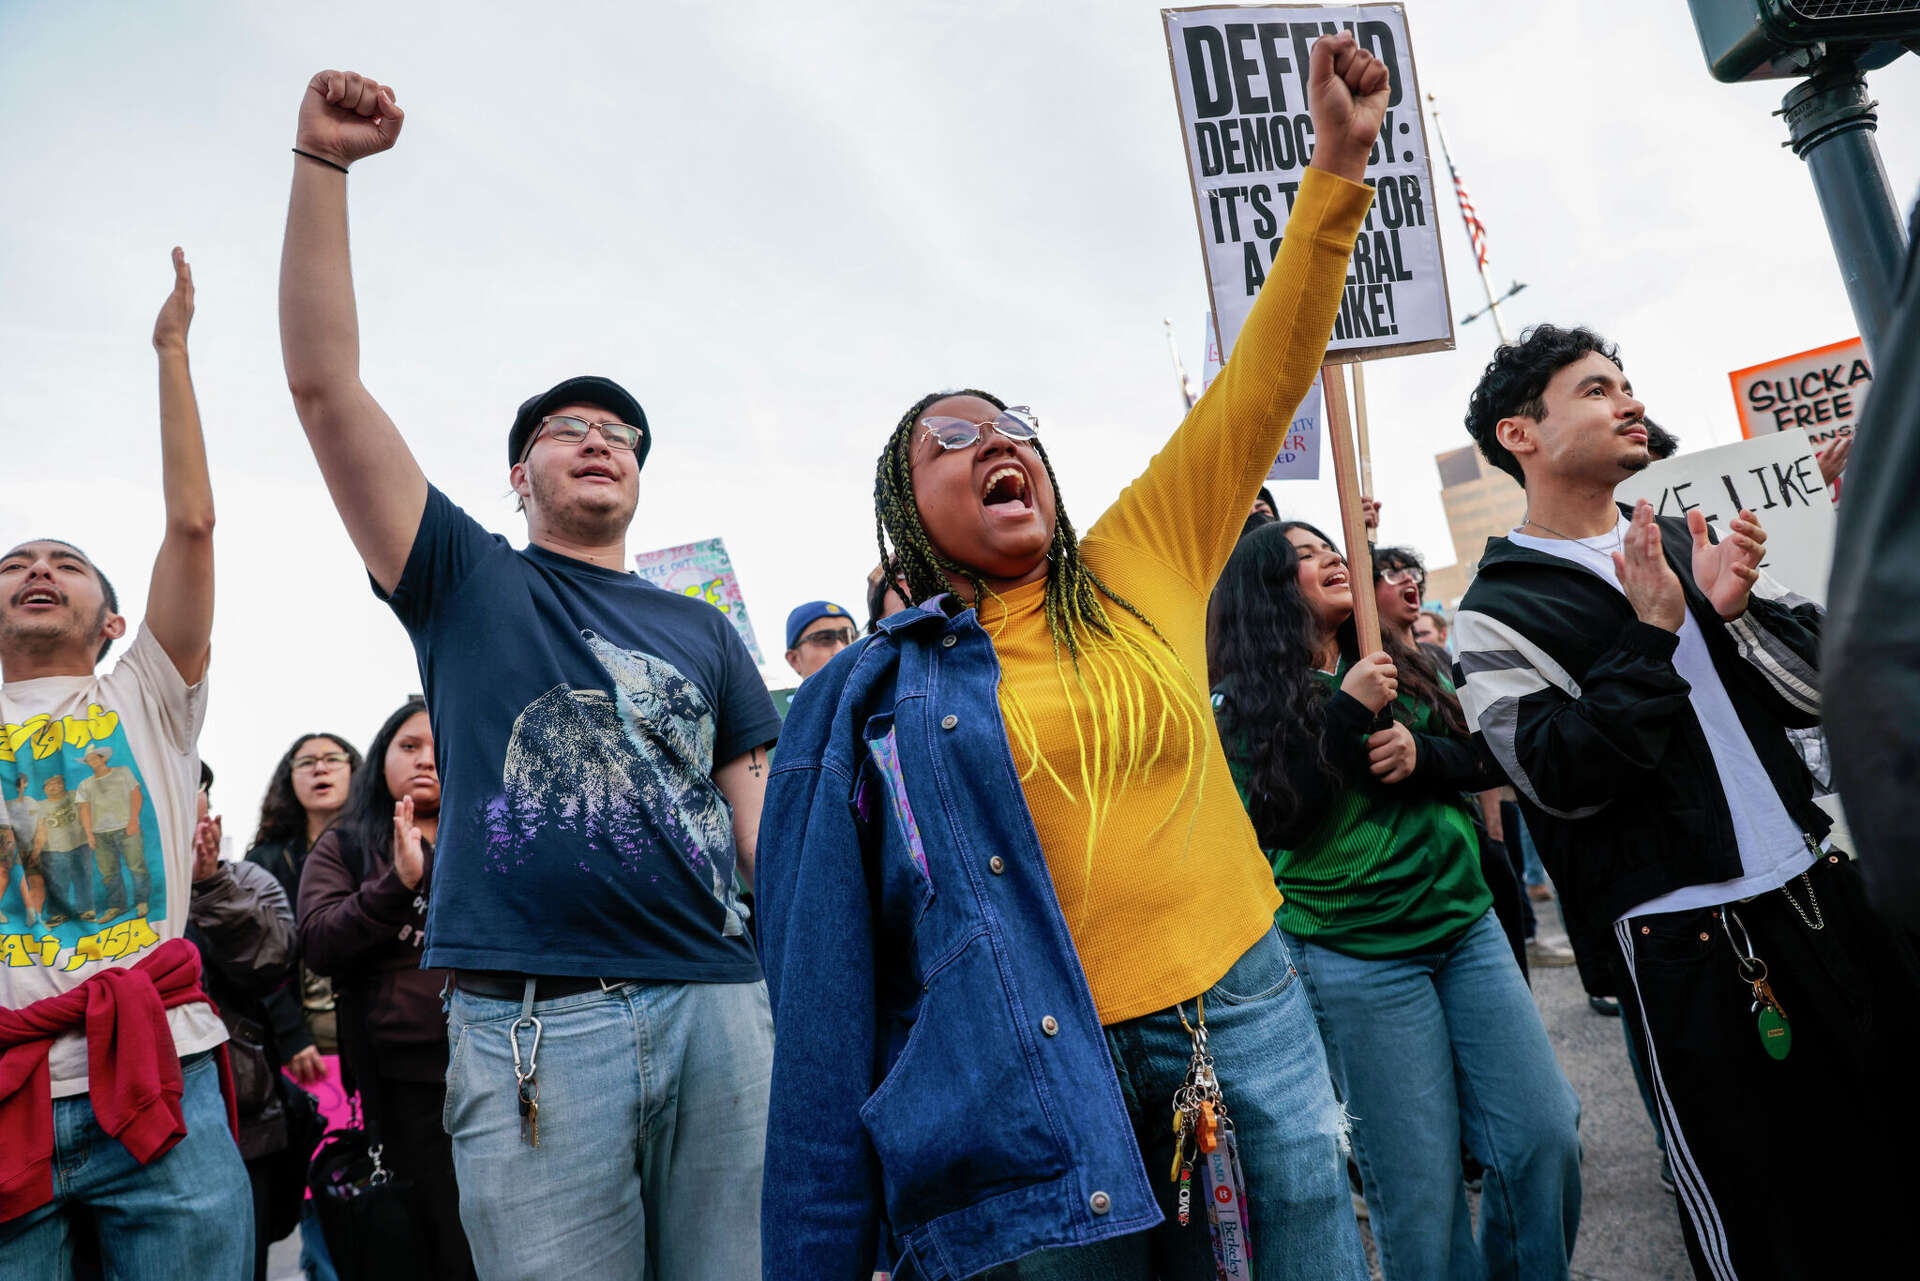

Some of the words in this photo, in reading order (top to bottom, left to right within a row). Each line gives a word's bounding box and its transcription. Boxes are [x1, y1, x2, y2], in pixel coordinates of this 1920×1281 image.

[1207, 184, 1278, 244] IT'S
[1748, 359, 1873, 411] SUCKA
[1773, 393, 1853, 432] FREE
[1721, 455, 1823, 518] LIKE
[1223, 1222, 1241, 1278] Berkeley
